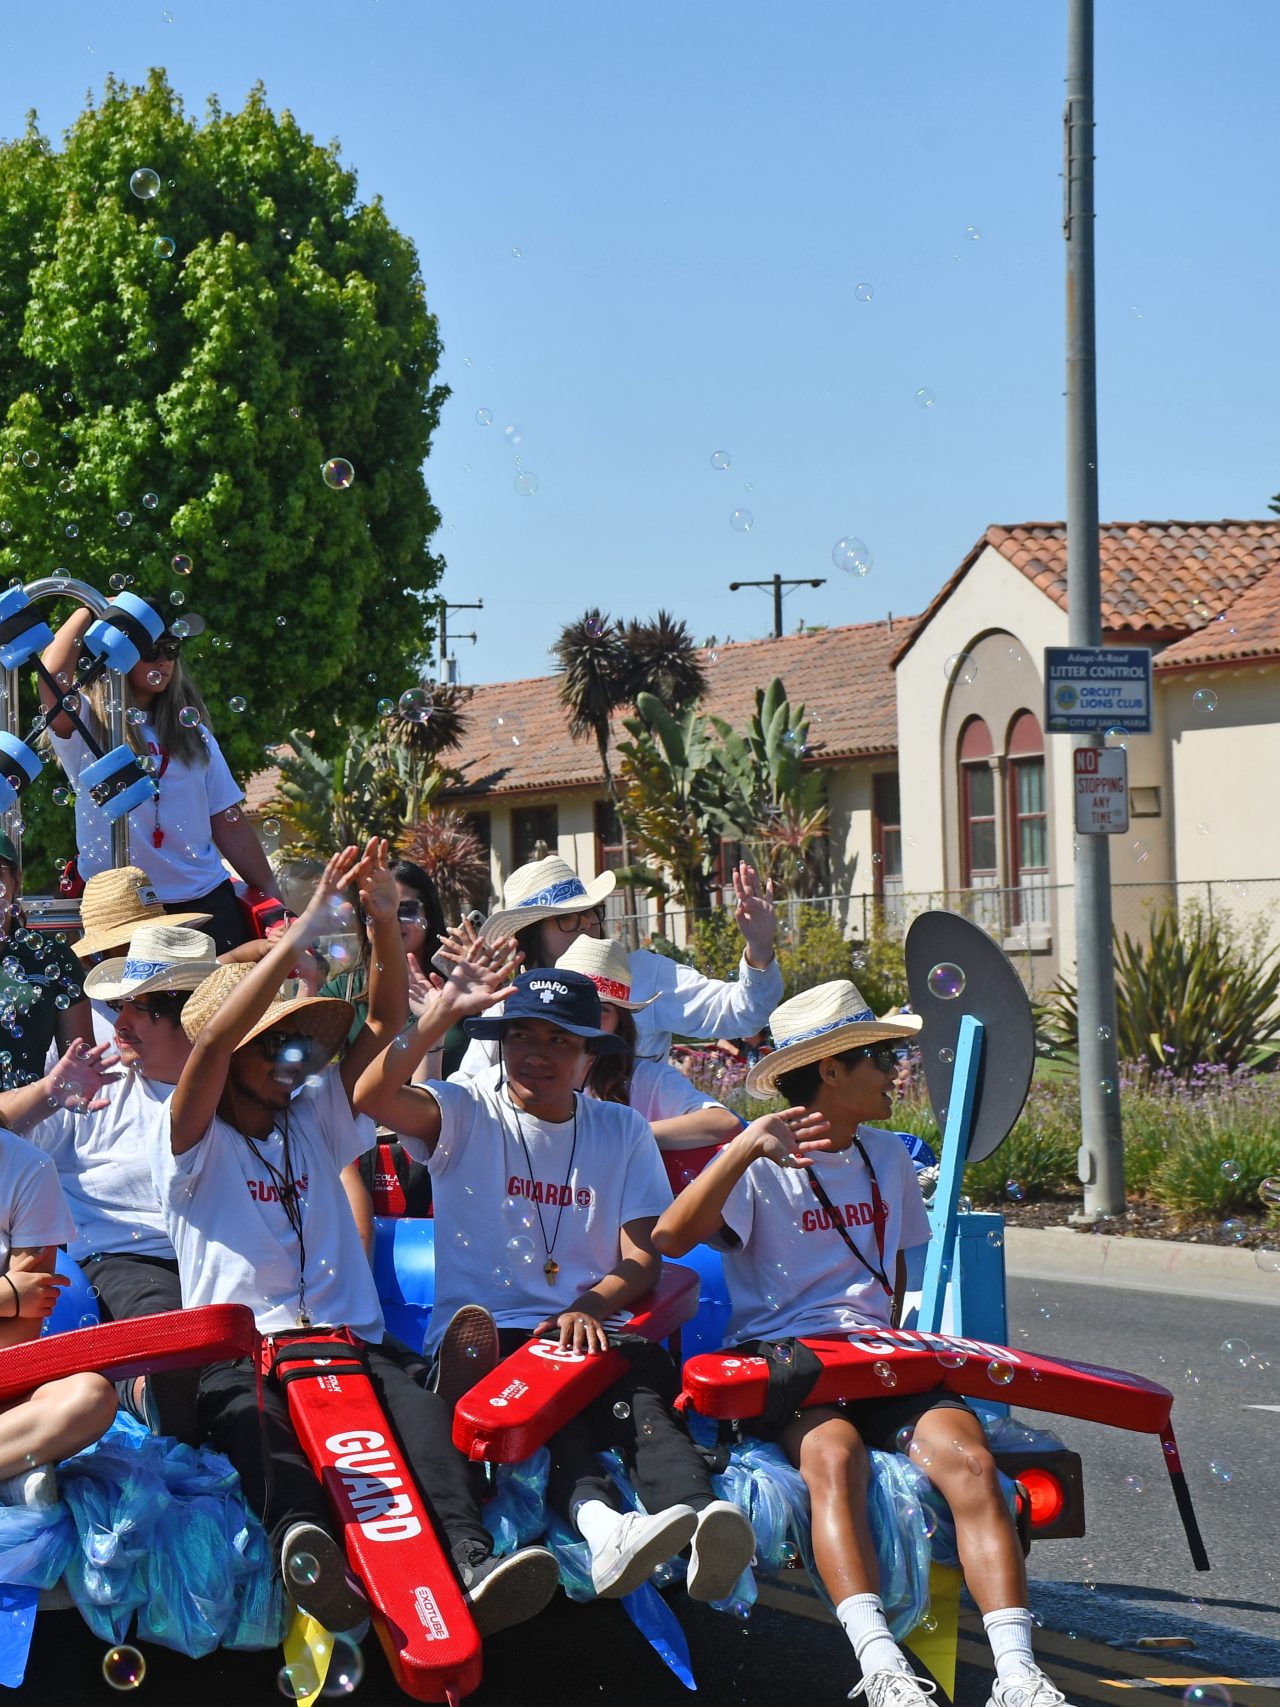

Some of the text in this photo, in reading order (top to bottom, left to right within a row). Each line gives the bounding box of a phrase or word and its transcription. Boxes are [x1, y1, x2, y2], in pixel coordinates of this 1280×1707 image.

[1050, 666, 1146, 678] LITTER CONTROL
[1080, 687, 1122, 697] ORCUTT
[1080, 698, 1144, 709] LIONS CLUB
[1069, 718, 1085, 727] CITY
[1086, 718, 1097, 727] OF
[1076, 751, 1095, 771] NO
[1078, 777, 1124, 794] STOPPING
[1092, 797, 1111, 808] ANY
[1091, 811, 1112, 824] TIME
[529, 980, 569, 996] GUARD
[508, 1176, 573, 1206] GUARD
[848, 1331, 1021, 1363] GUARD
[326, 1430, 422, 1542] GUARD
[418, 1589, 445, 1637] EXOTUBE
